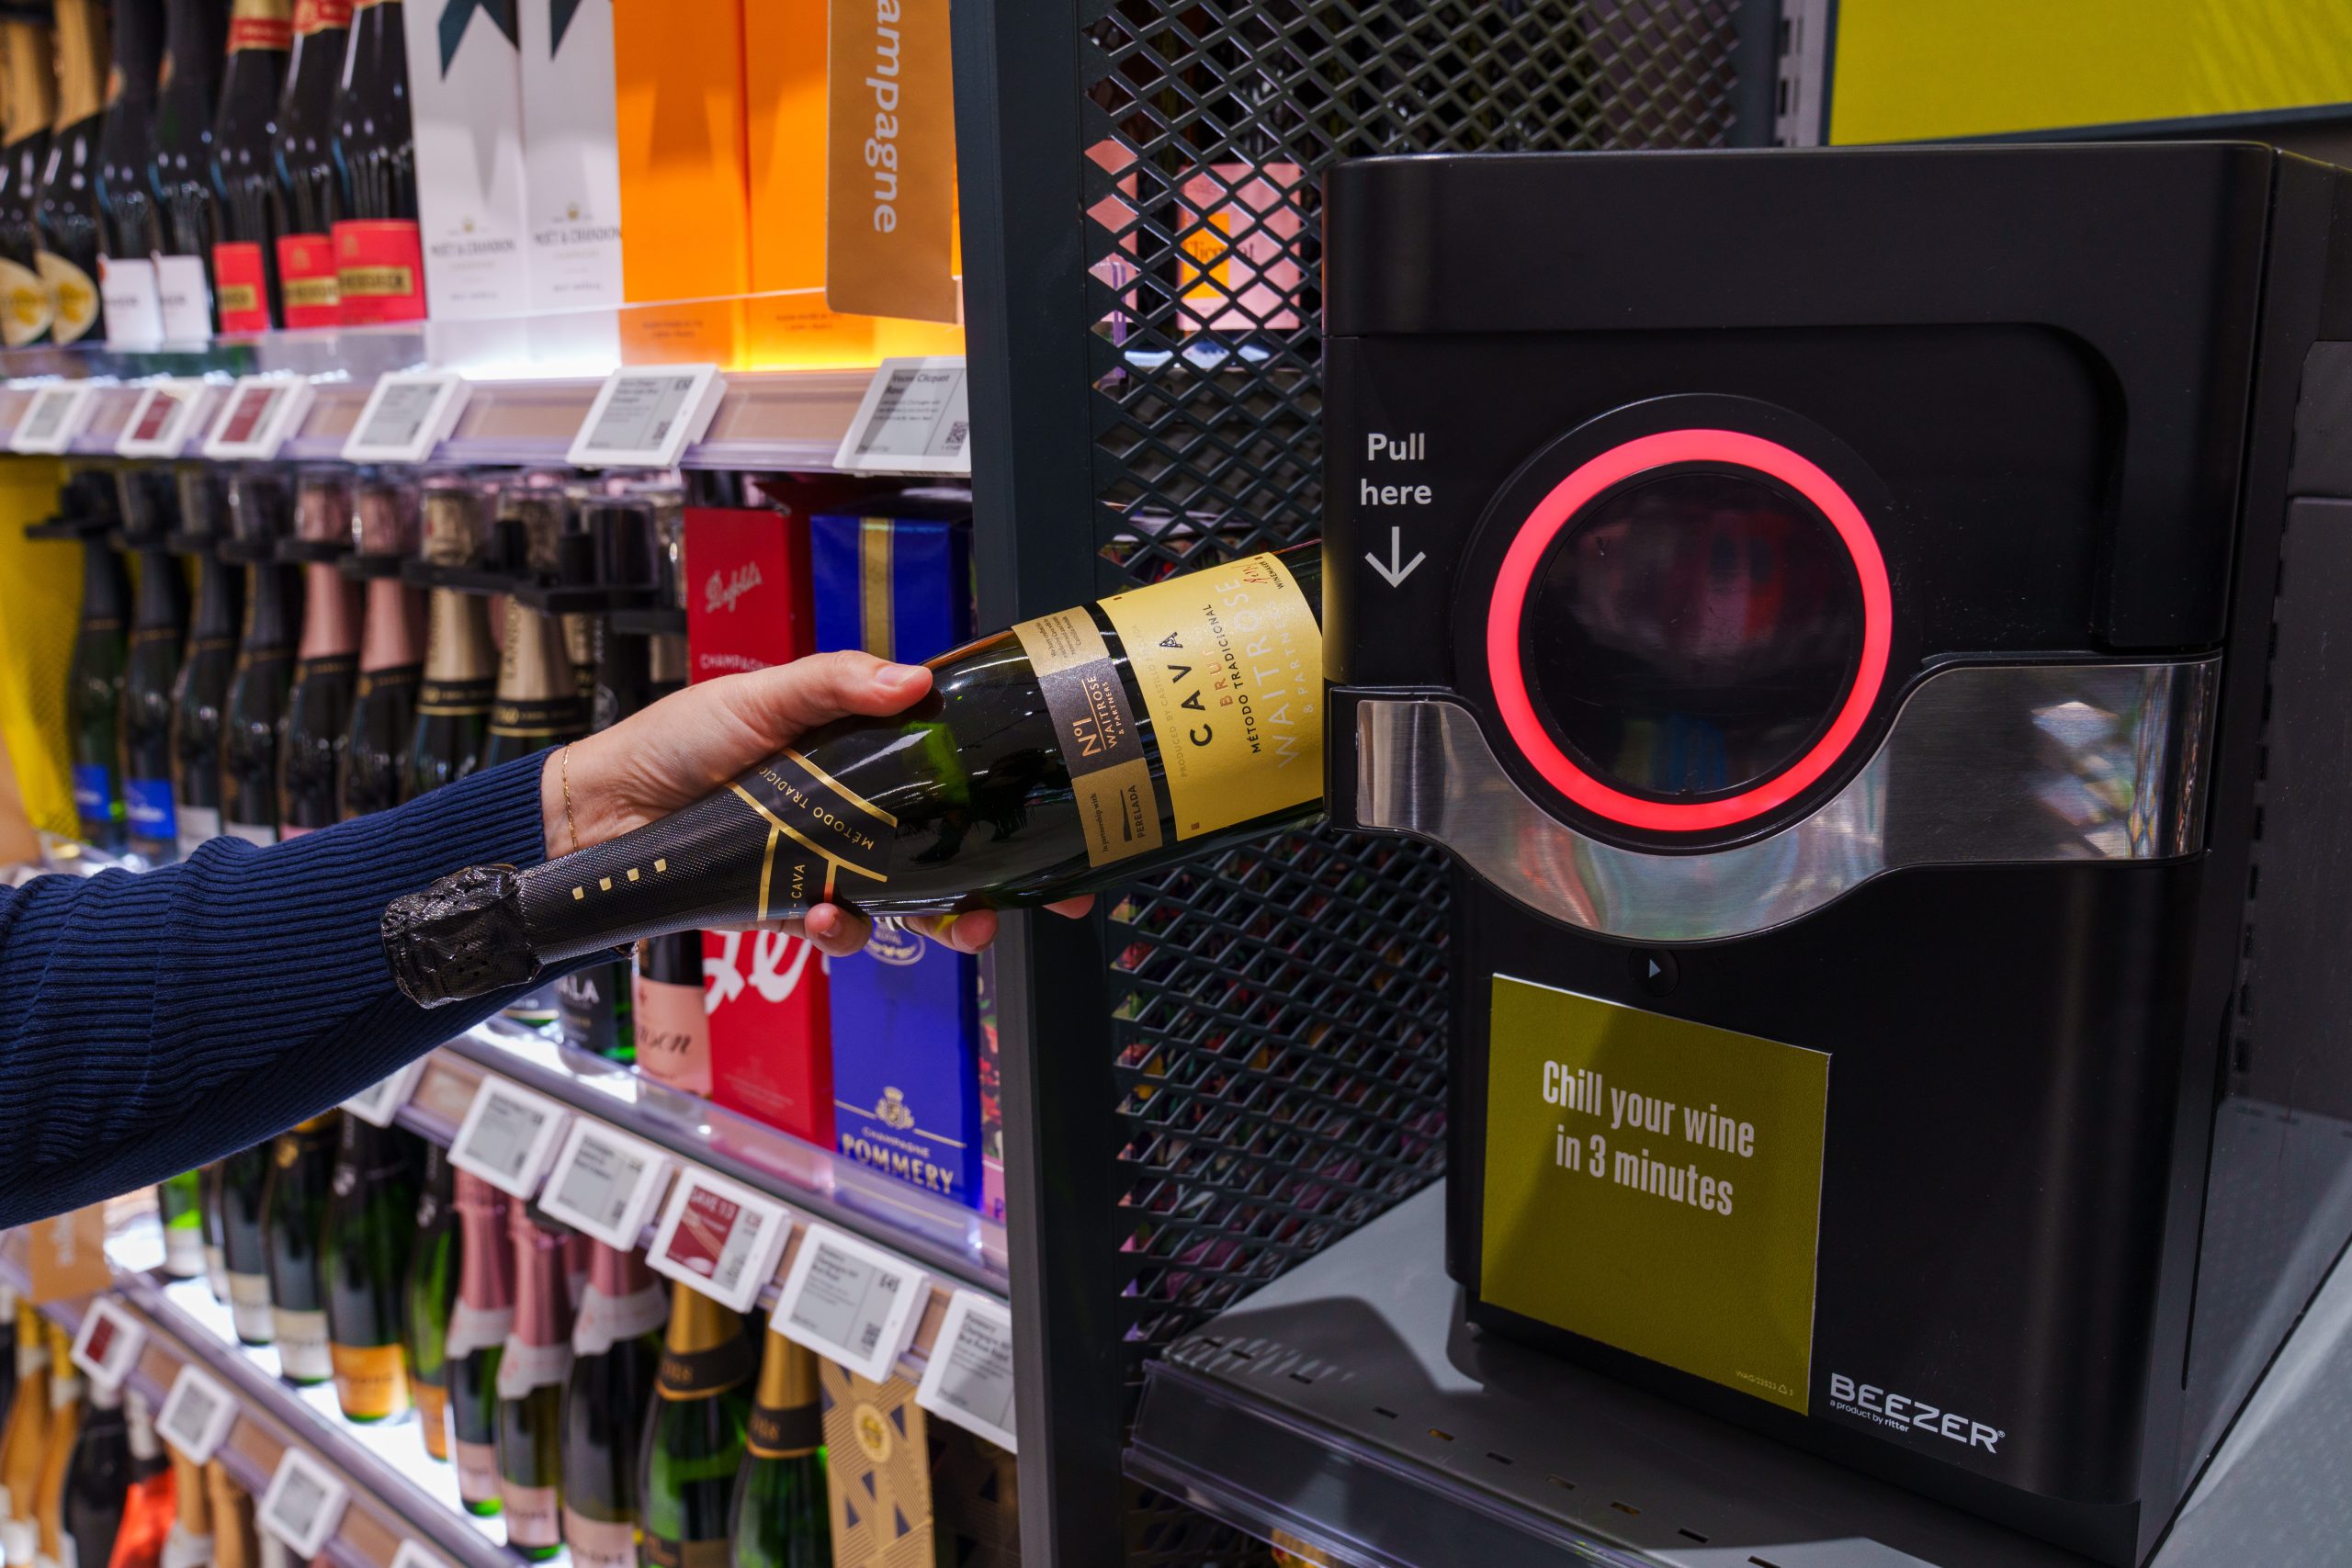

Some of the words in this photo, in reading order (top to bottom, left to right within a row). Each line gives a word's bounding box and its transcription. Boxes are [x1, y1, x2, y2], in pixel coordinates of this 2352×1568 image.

[865, 0, 900, 233] ampagne
[1367, 433, 1426, 461] Pull
[1361, 479, 1432, 505] here
[1203, 604, 1243, 690] TRADICIONAL
[1215, 577, 1300, 768] WAITROSE
[1102, 682, 1122, 727] PARTNERS
[1159, 631, 1213, 747] CAVA
[1202, 648, 1234, 707] BRUT
[1087, 675, 1118, 749] WAITROSE
[1163, 710, 1174, 721] BY
[1238, 694, 1261, 753] MÉTODO
[1170, 726, 1188, 778] PRODUCED
[812, 807, 875, 851] MÉTODO
[1127, 784, 1147, 839] PERELADA
[791, 864, 806, 898] CAVA
[1543, 1060, 1602, 1116] Chill
[1611, 1087, 1676, 1135] your
[1684, 1103, 1755, 1157] wine
[842, 1133, 954, 1194] POMMERY
[1556, 1123, 1580, 1171] in
[1589, 1134, 1606, 1178] 3
[1614, 1148, 1733, 1215] minutes
[1837, 1401, 1871, 1419] product
[1872, 1413, 1883, 1425] by
[1884, 1417, 1909, 1433] ritter
